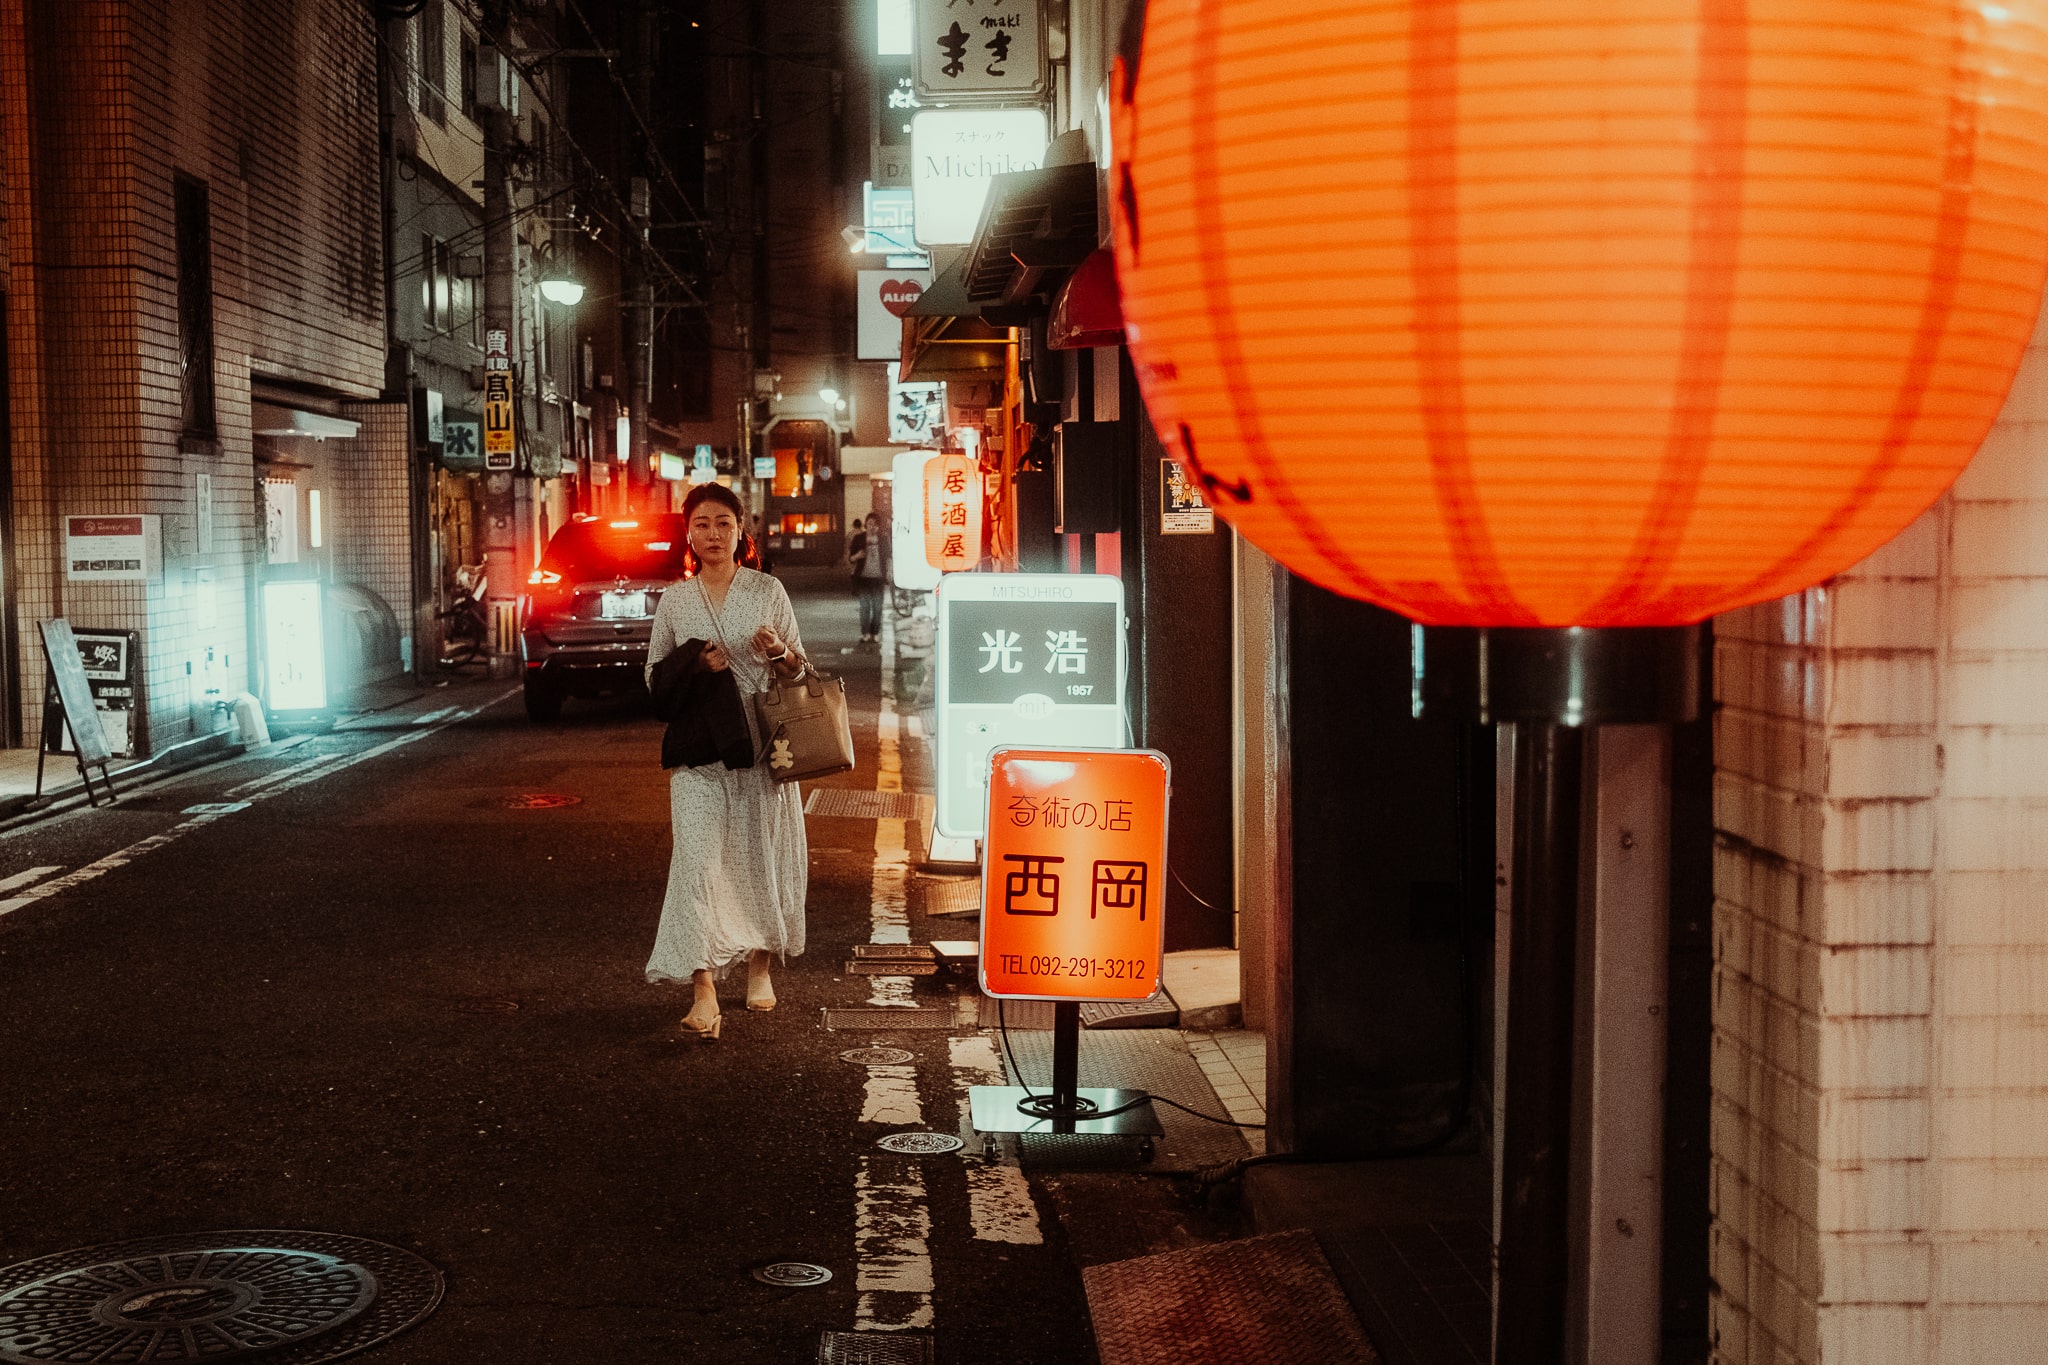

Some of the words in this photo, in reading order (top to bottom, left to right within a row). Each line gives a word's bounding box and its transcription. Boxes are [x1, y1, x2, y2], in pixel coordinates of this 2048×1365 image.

[979, 13, 1021, 29] maki
[936, 21, 1012, 79] まき
[954, 130, 1006, 145] スナック
[924, 154, 1037, 179] Michiko
[486, 329, 508, 356] 質
[941, 470, 967, 558] 居酒屋
[992, 586, 1074, 599] MITSUHIRO
[978, 629, 1089, 675] 光浩
[1066, 684, 1094, 697] 1957
[1007, 794, 1134, 832] 奇術の店
[1003, 853, 1148, 922] 西岡
[1000, 954, 1028, 975] TEL
[1030, 955, 1146, 980] 092-291-3212
